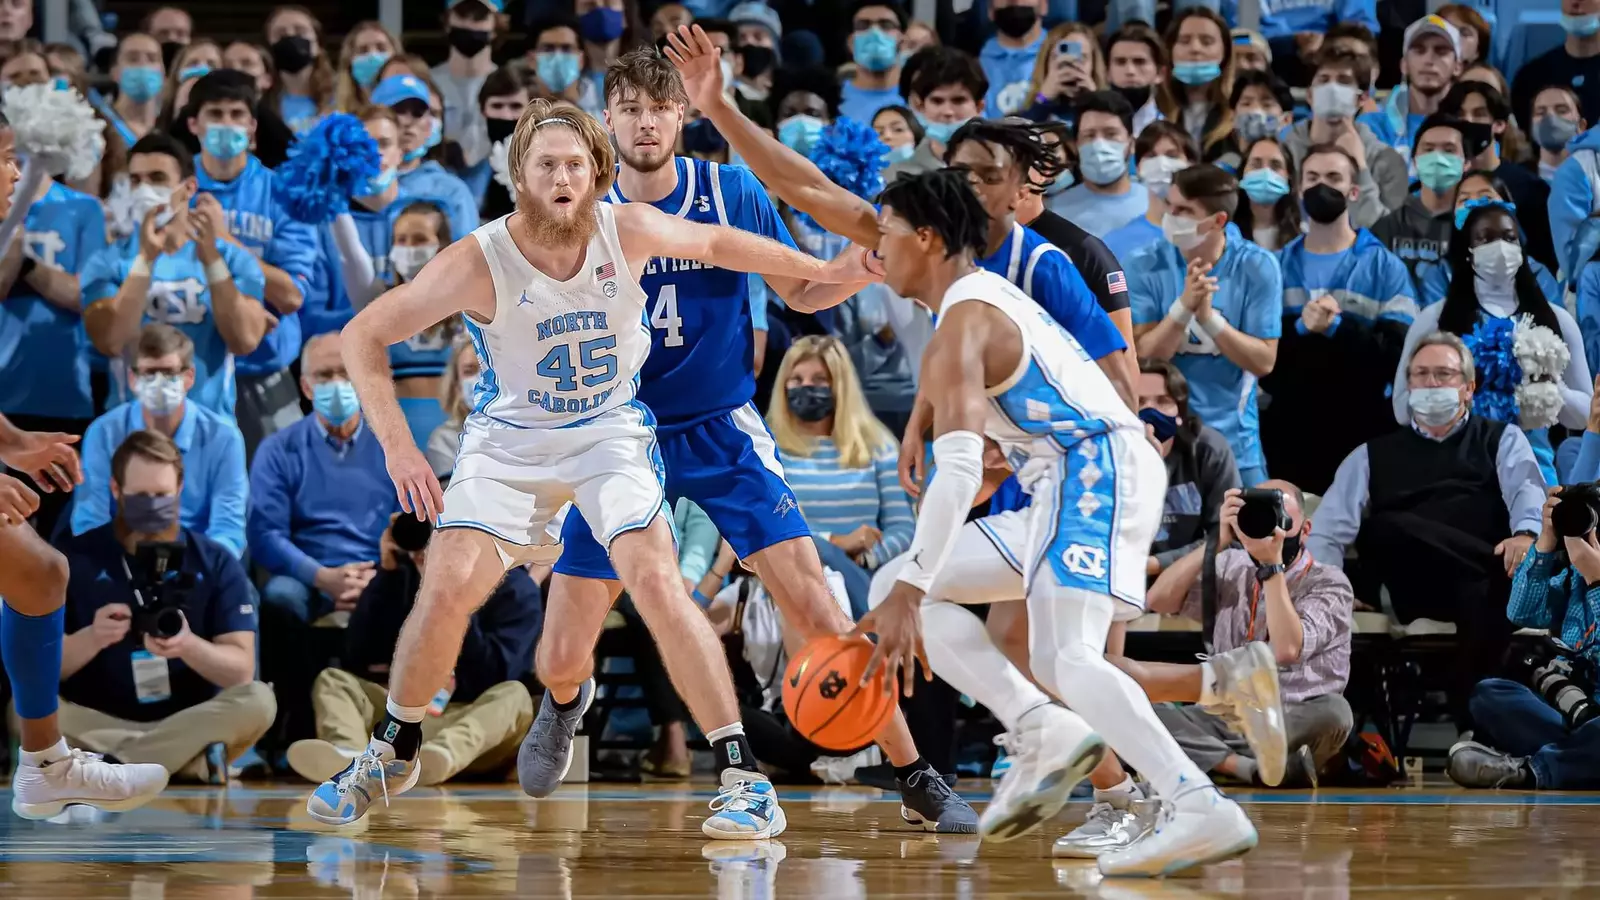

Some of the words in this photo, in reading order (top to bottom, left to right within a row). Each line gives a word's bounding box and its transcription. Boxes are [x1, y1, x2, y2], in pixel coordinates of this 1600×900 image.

[536, 311, 608, 341] NORTH
[650, 284, 684, 347] 4
[536, 334, 618, 392] 45
